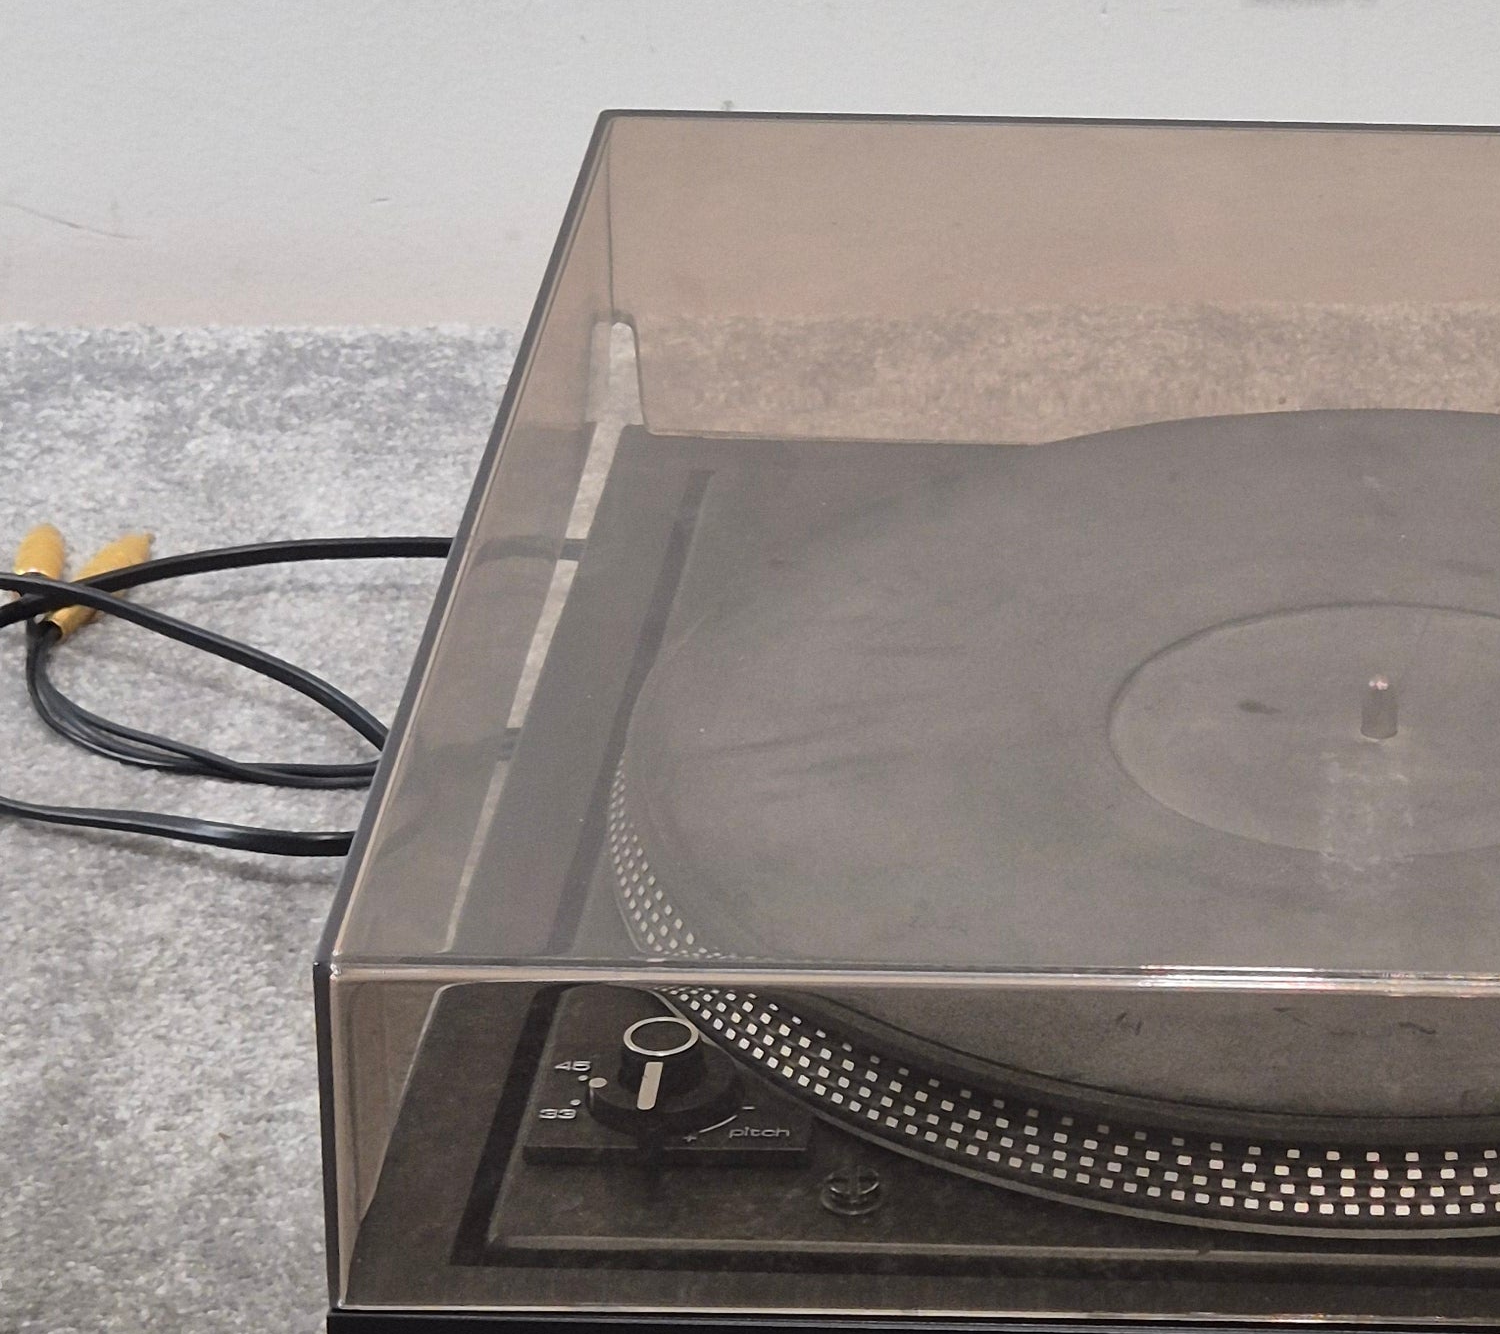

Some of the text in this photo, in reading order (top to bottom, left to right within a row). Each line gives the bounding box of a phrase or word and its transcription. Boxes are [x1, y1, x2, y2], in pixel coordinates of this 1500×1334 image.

[554, 1060, 591, 1072] 45
[539, 1108, 577, 1119] 33
[728, 1127, 790, 1139] pitch
